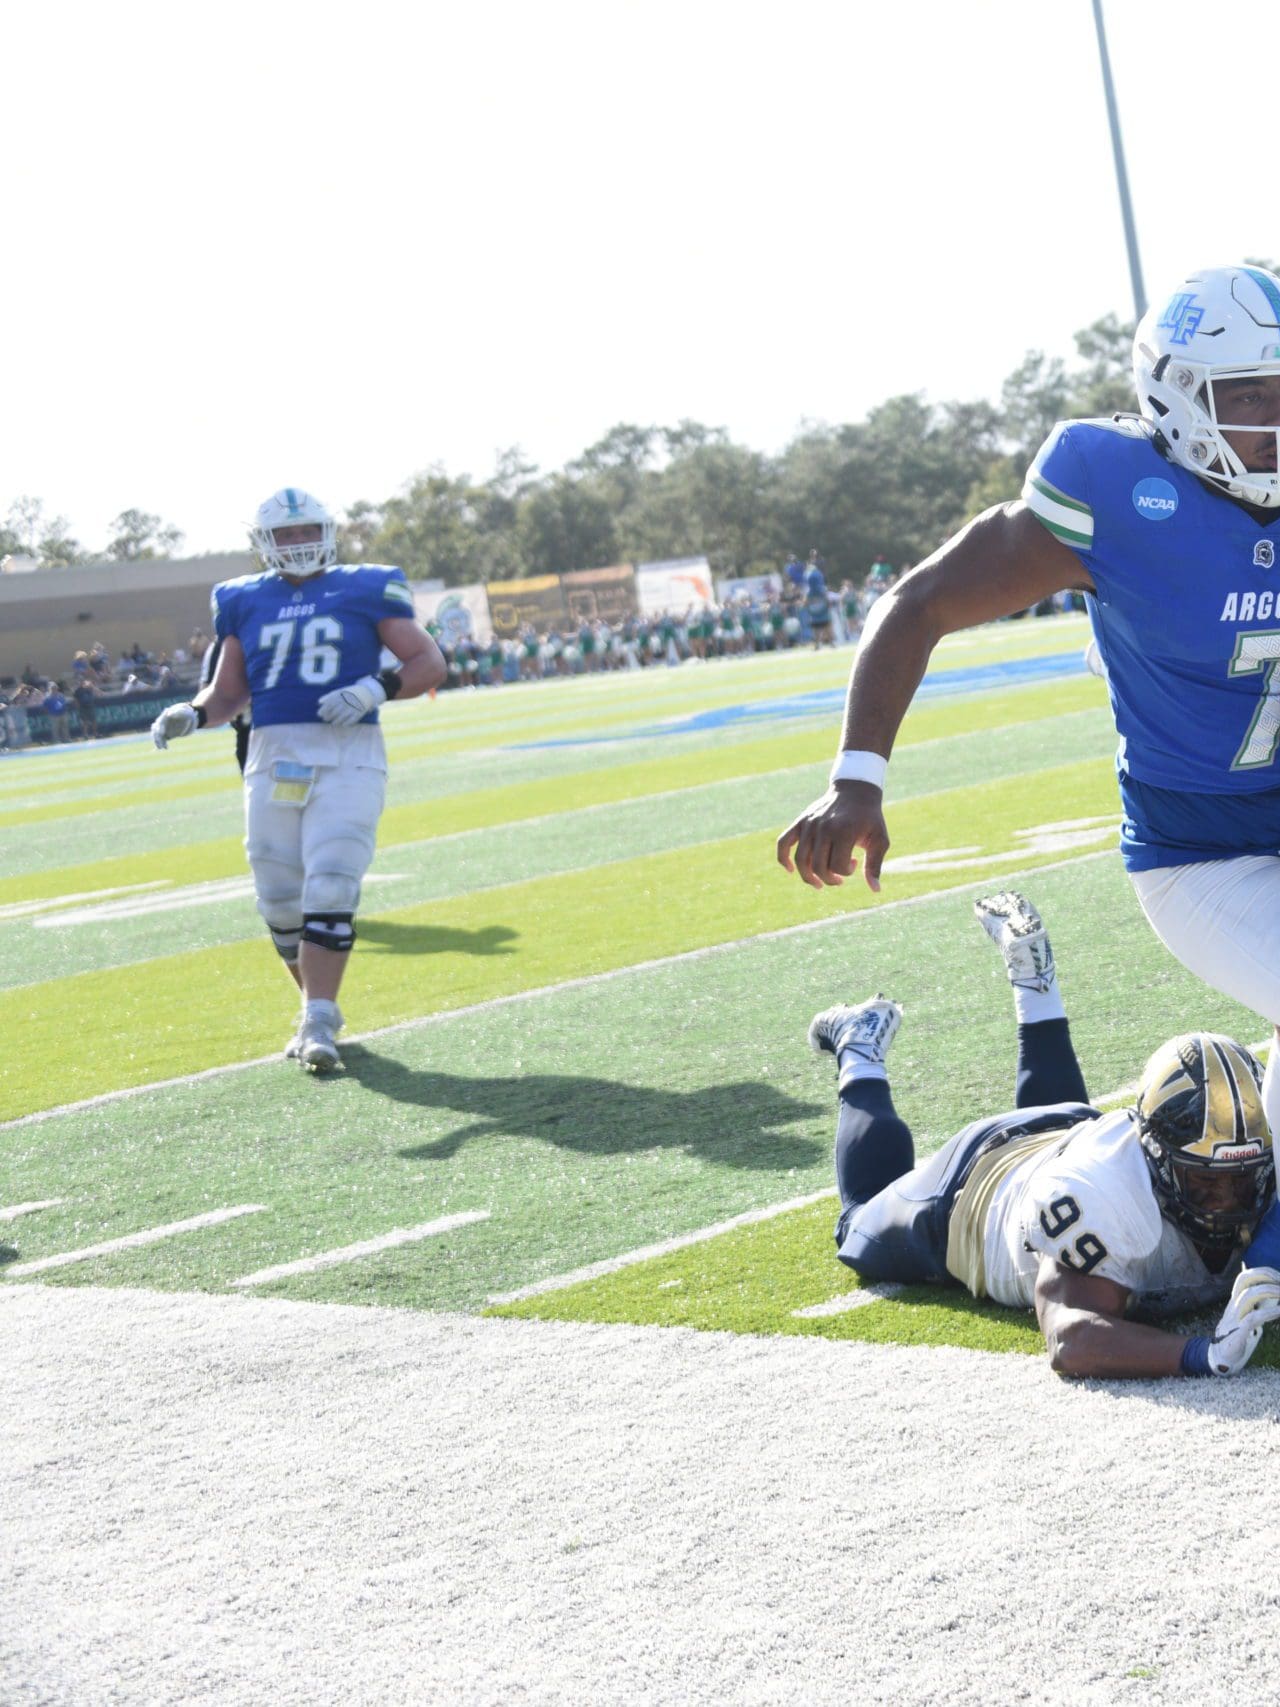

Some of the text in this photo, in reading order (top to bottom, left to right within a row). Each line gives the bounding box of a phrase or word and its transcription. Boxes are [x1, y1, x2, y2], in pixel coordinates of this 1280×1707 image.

[1138, 496, 1177, 511] NCAA
[278, 602, 316, 619] ARGOS
[259, 615, 343, 690] 76
[1039, 1194, 1108, 1274] 99
